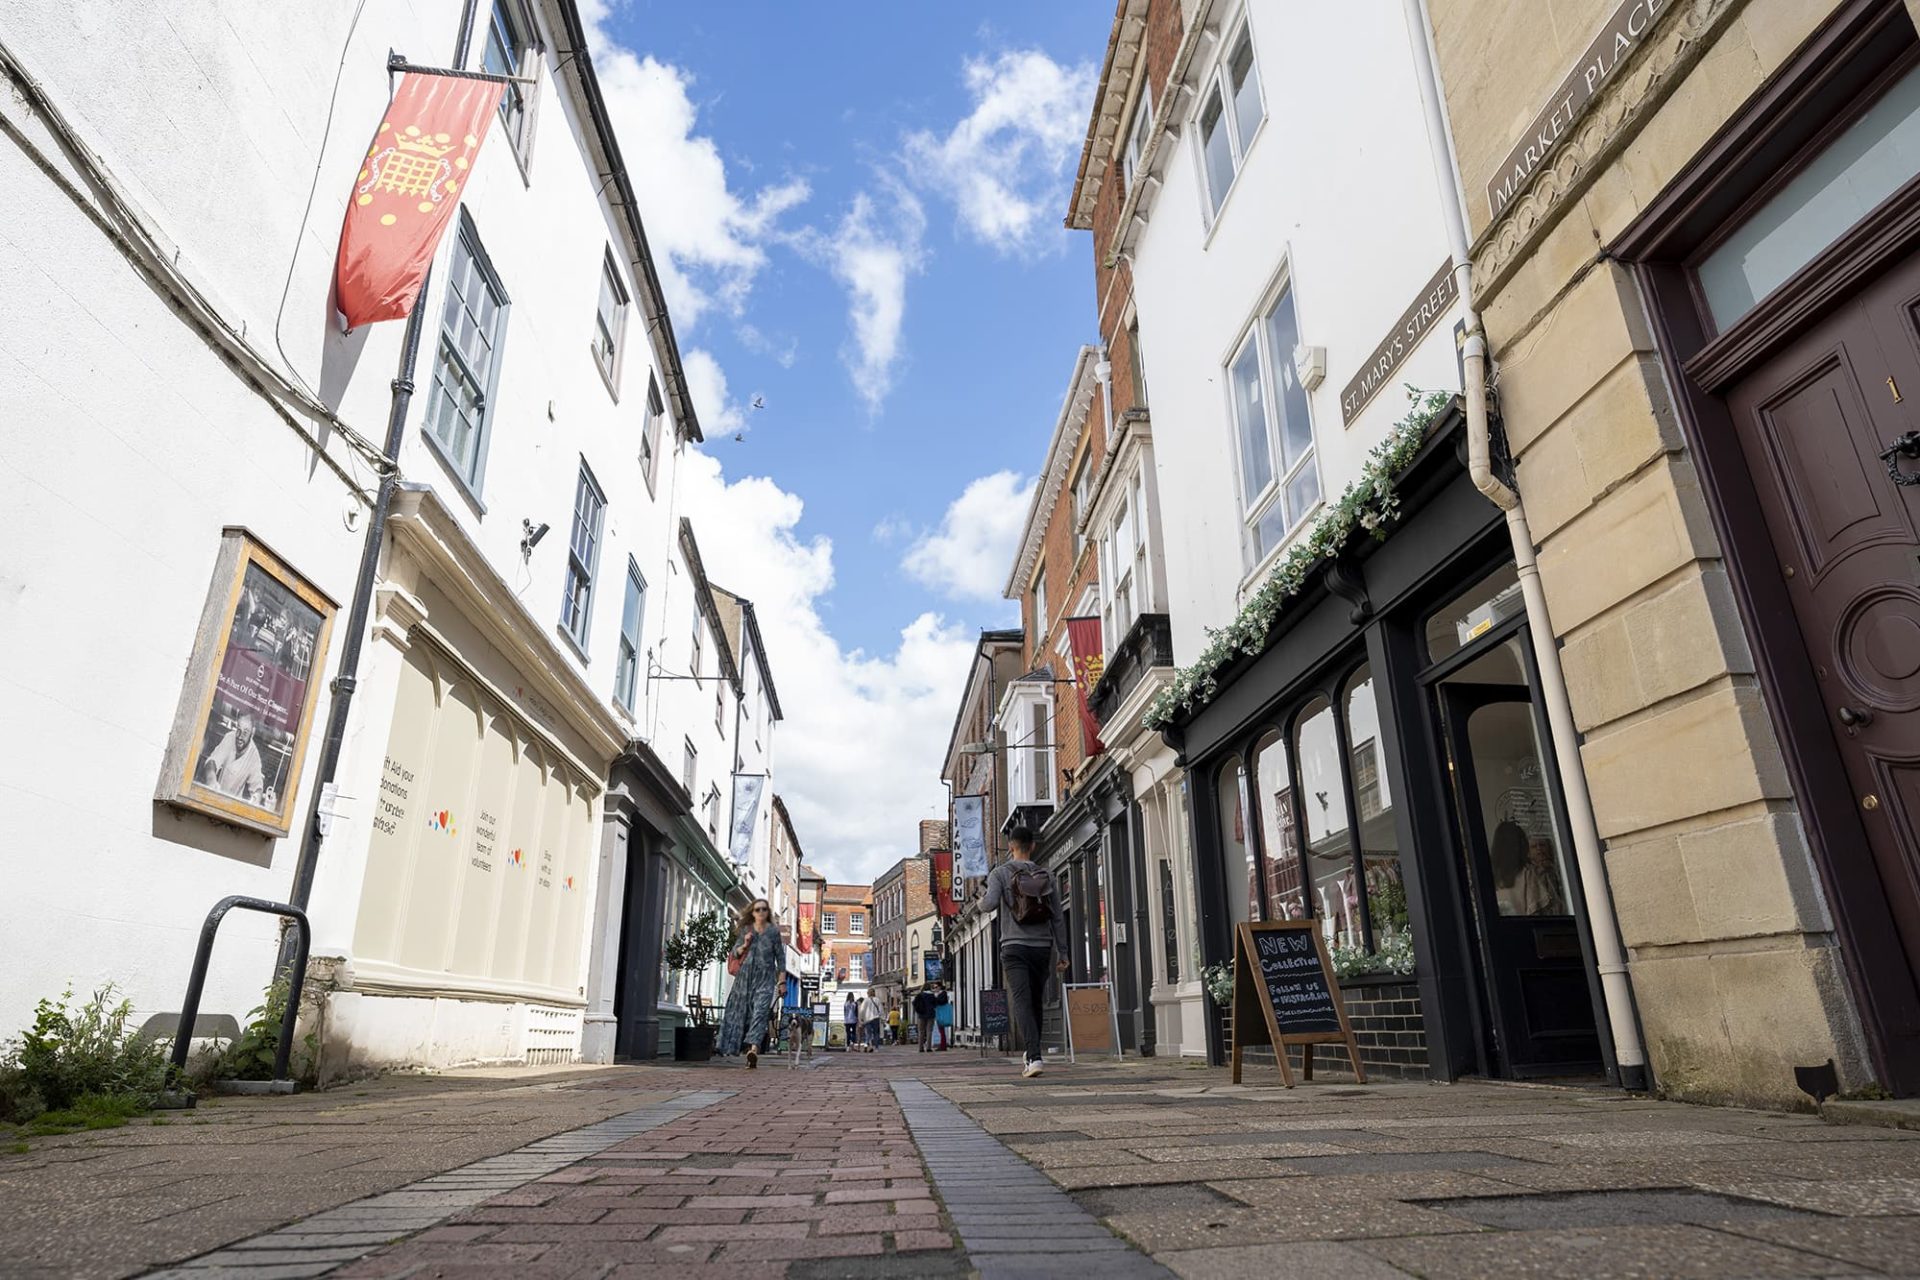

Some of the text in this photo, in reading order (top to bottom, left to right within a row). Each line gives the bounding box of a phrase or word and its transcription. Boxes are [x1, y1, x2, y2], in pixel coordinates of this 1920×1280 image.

[1496, 92, 1575, 210] MARKET
[1344, 272, 1454, 418] ST. MARY'S STREET
[1259, 935, 1308, 956] NEW
[1280, 991, 1330, 1005] INSTAGRAM
